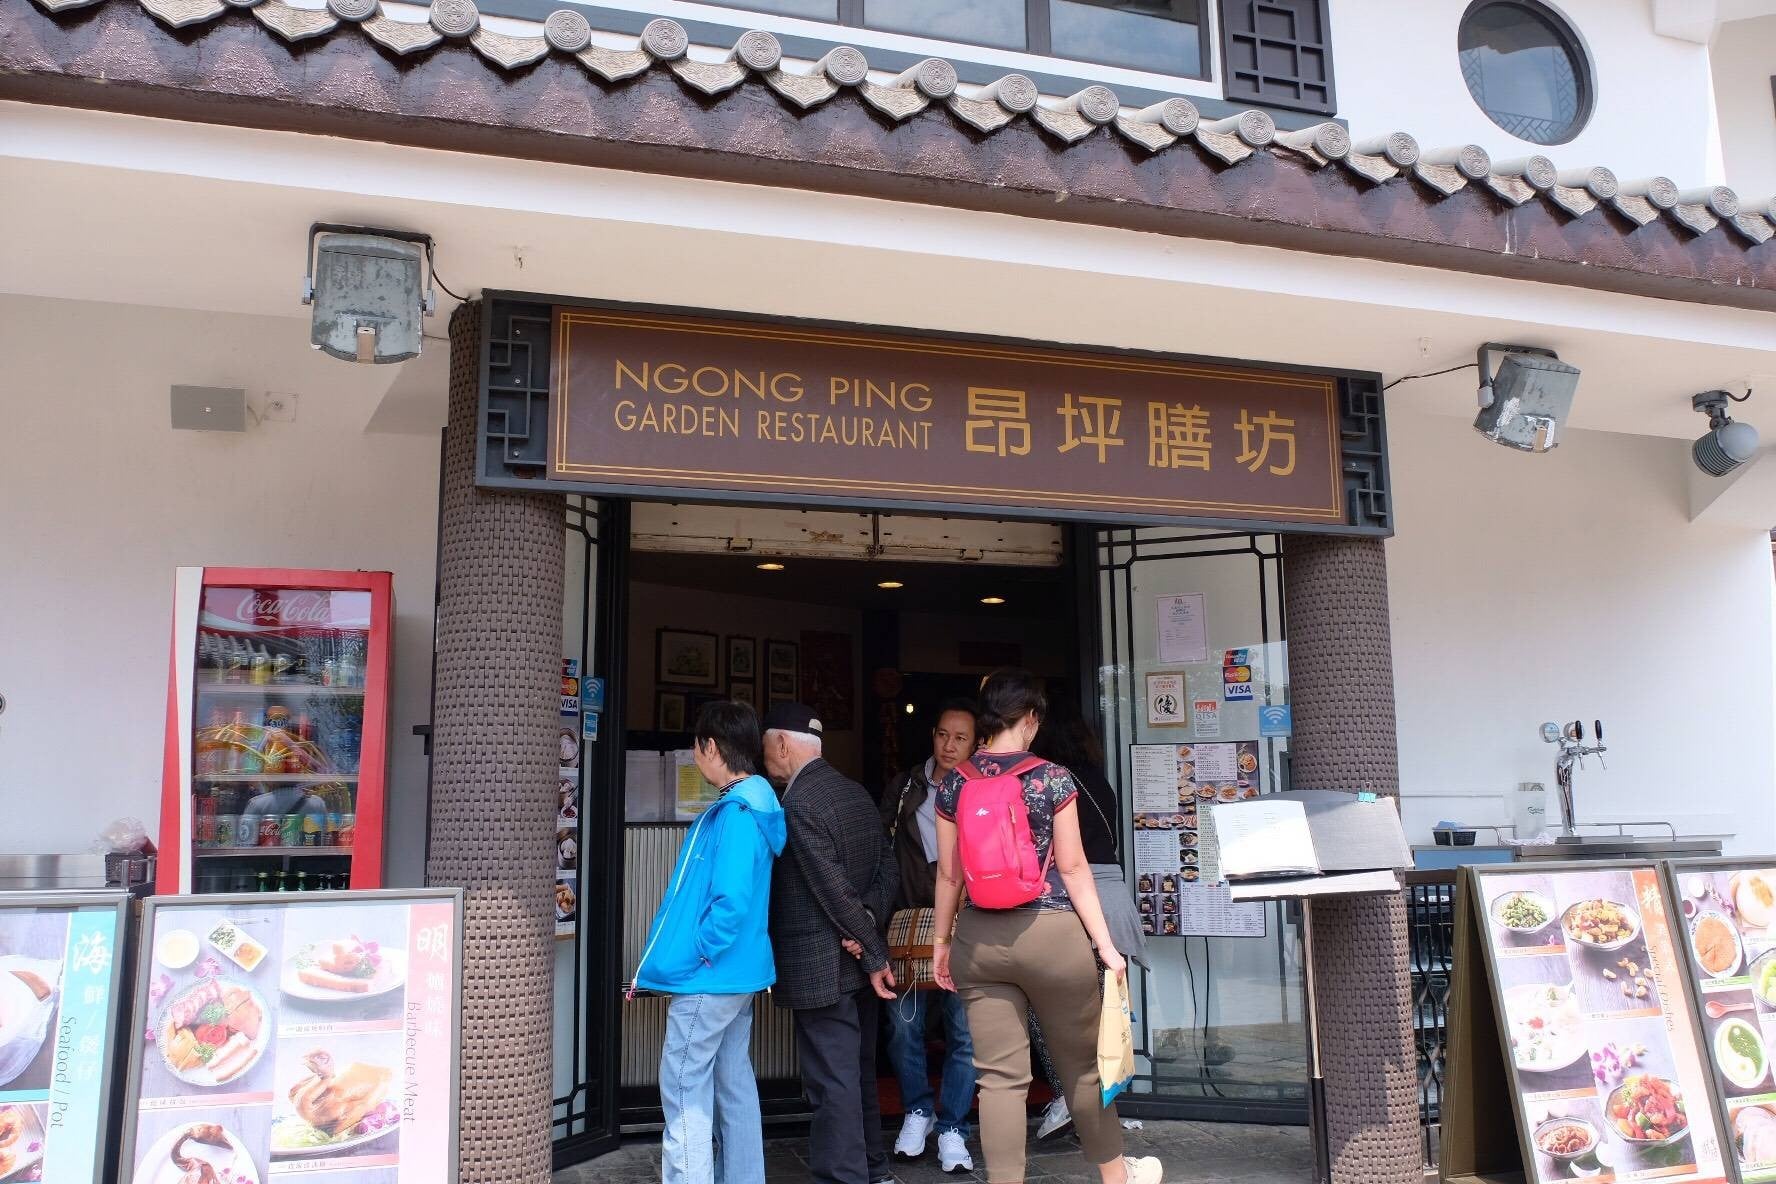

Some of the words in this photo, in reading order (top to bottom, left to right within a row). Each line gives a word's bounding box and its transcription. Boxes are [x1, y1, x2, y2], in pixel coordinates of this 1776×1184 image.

[615, 359, 804, 402] NGONG
[829, 376, 933, 412] PING
[614, 400, 739, 438] GARDEN
[757, 410, 933, 450] RESTAURANT
[965, 387, 1296, 476] 昂坪膳坊
[561, 699, 578, 709] VISA
[1228, 685, 1252, 694] VISA
[55, 1016, 76, 1083] Seafood
[405, 1002, 422, 1075] Barbecue
[50, 1102, 70, 1128] Pot
[404, 1082, 418, 1121] Meat
